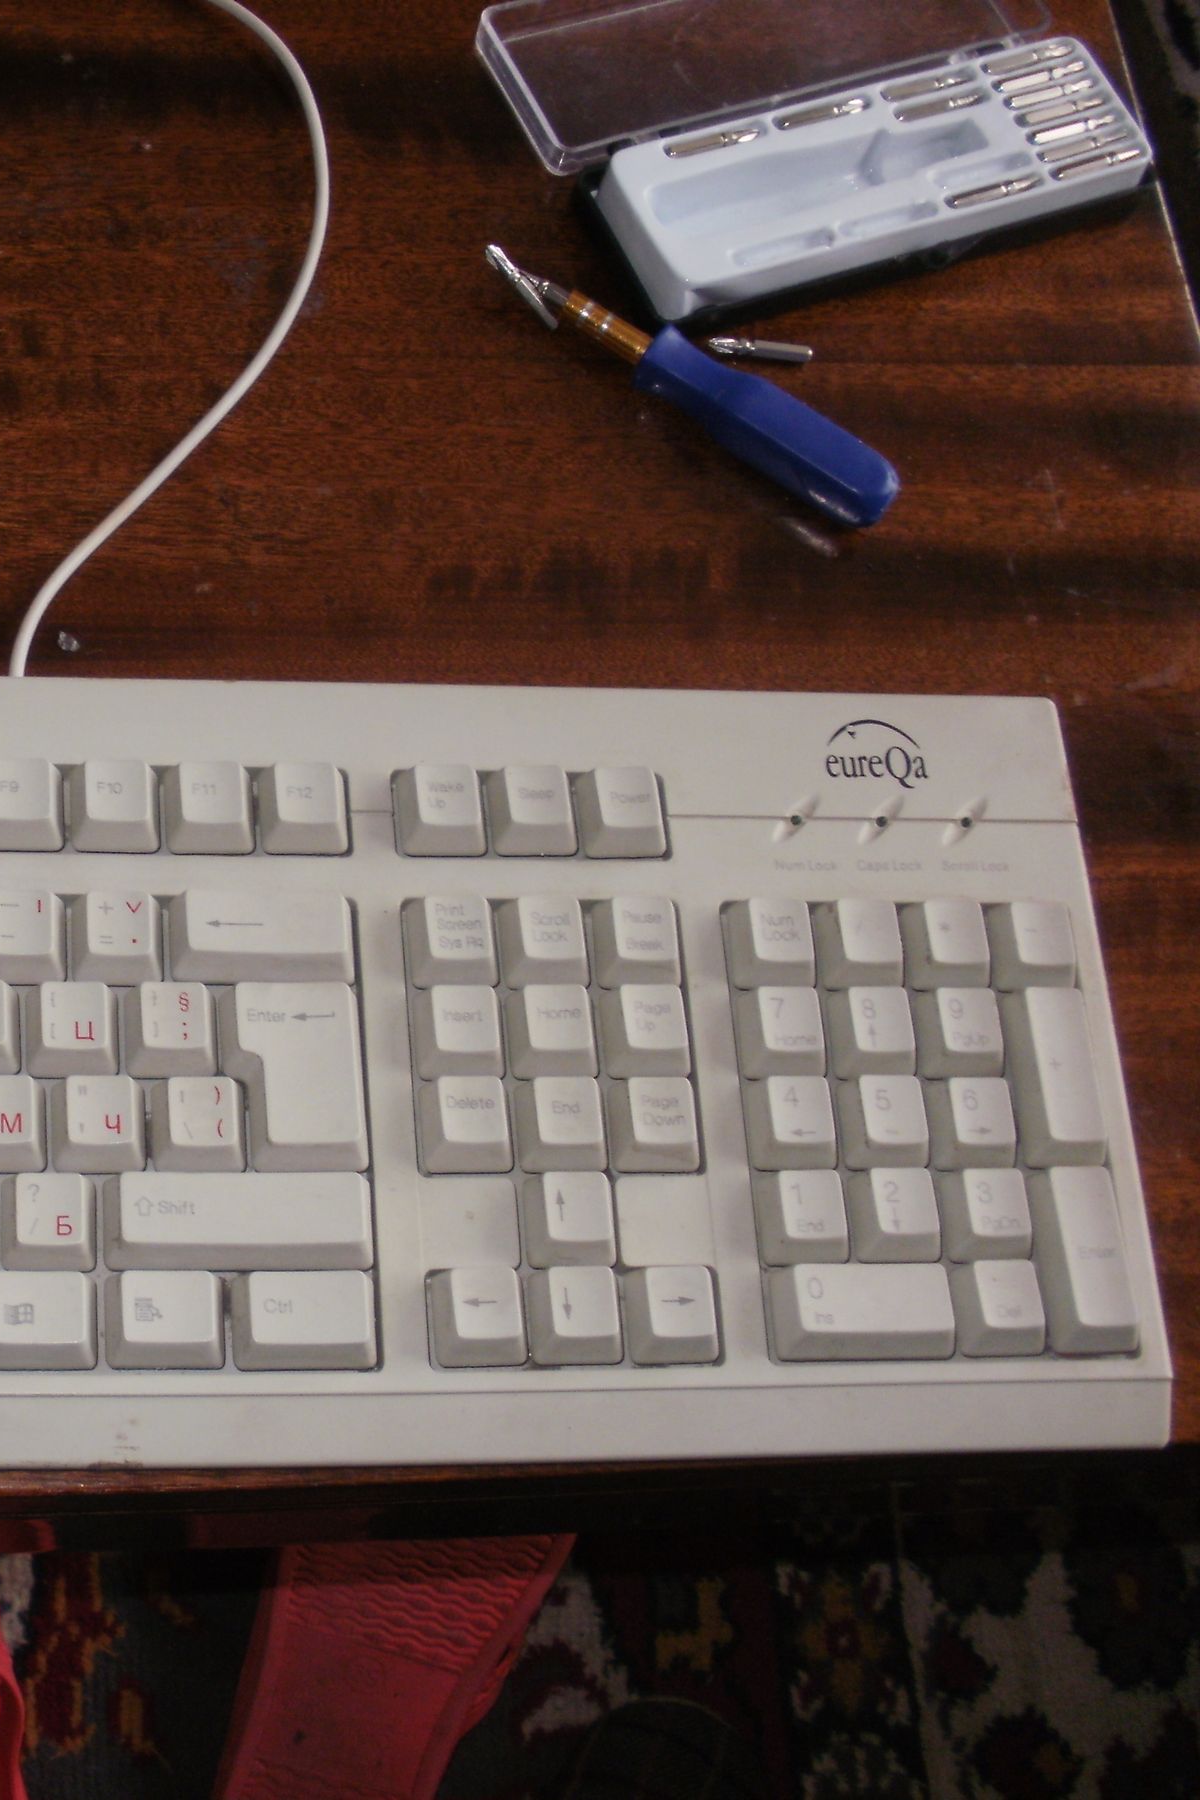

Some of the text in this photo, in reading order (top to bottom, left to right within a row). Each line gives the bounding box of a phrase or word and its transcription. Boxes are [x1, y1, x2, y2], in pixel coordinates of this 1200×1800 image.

[825, 746, 929, 789] eureQa
[247, 1008, 286, 1023] Enter
[769, 997, 785, 1019] 7
[861, 998, 877, 1019] 8
[949, 998, 965, 1020] 9
[783, 1086, 799, 1107] 4
[875, 1089, 892, 1111] 5
[962, 1089, 979, 1111] 6
[883, 1180, 900, 1203] 2
[976, 1181, 993, 1204] 3
[158, 1200, 195, 1215] Shift
[263, 1298, 293, 1314] Ctrl
